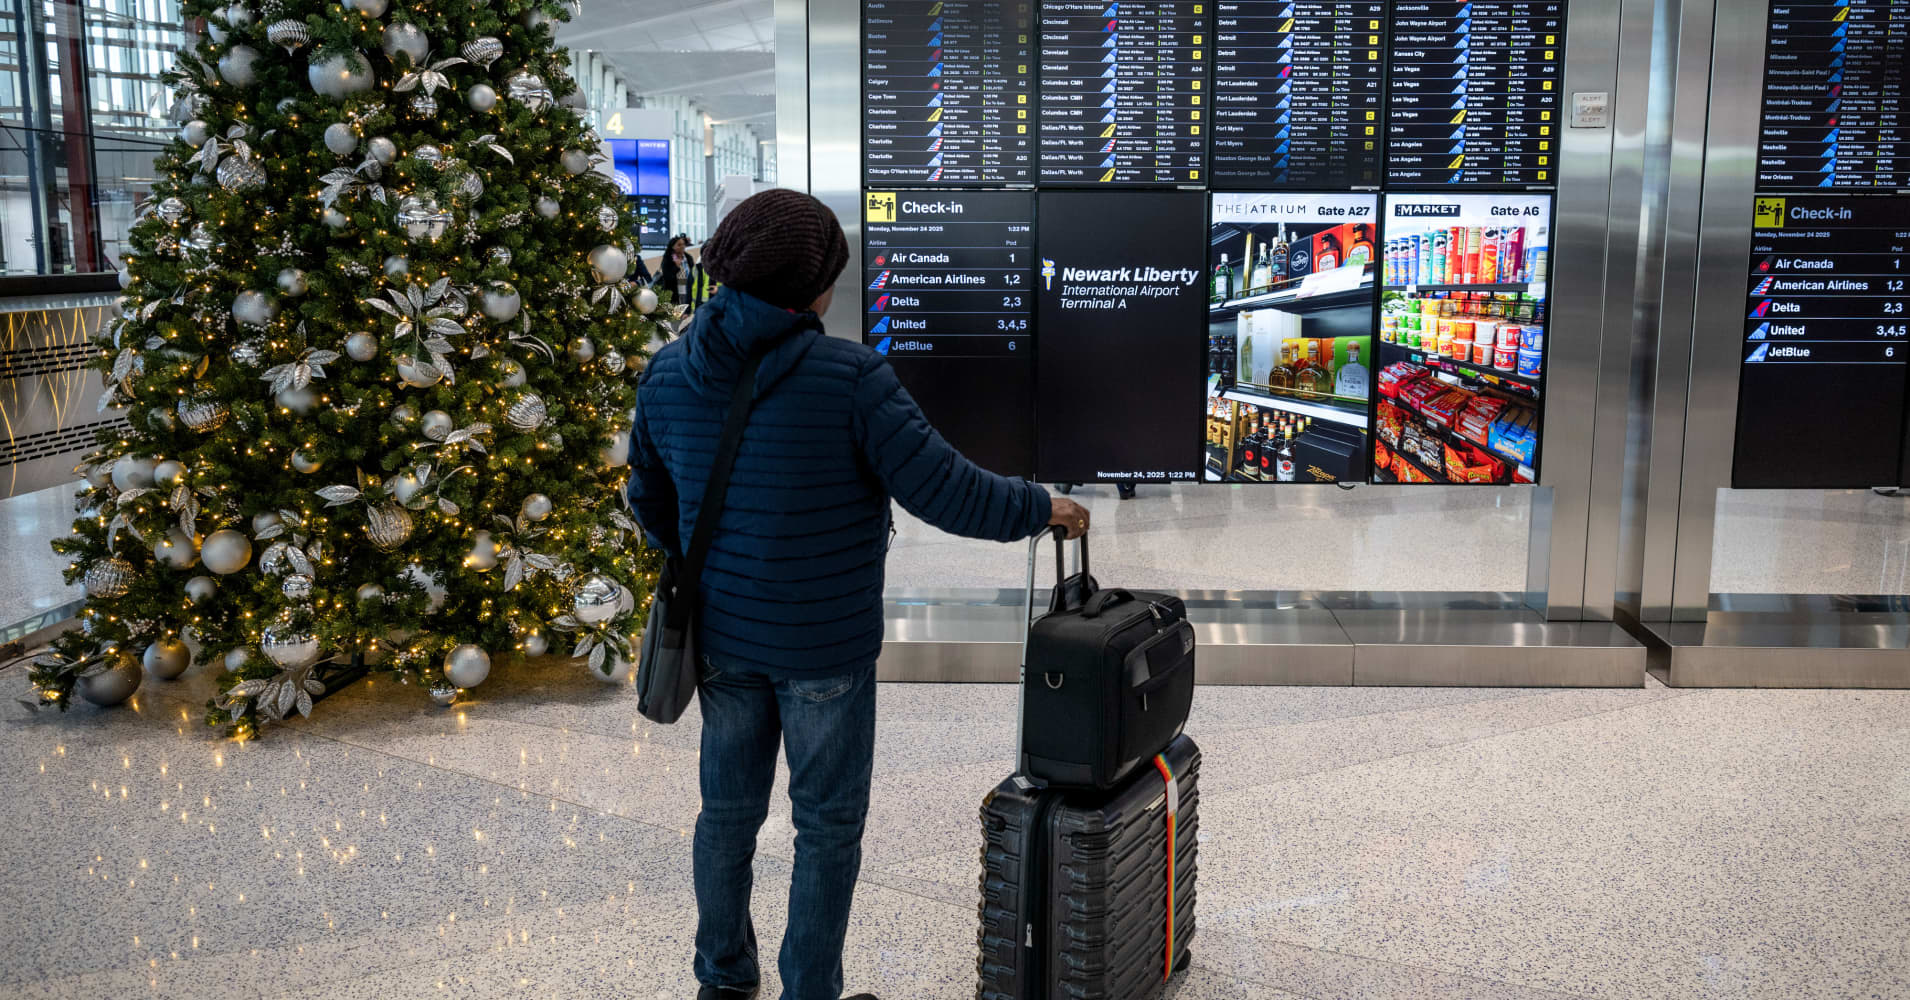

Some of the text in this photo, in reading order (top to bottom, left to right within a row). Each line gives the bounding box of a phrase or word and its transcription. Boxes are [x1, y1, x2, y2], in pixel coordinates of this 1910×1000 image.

[607, 112, 624, 134] 4
[902, 201, 963, 213] Check-in
[1216, 204, 1305, 213] THE ATRIUM
[1318, 207, 1370, 215] Gate A27
[1401, 204, 1458, 215] MARKET
[1491, 206, 1539, 216] Gate A6
[1791, 207, 1851, 219] Check-in
[892, 253, 949, 262] Air Canada
[1010, 254, 1014, 262] 1
[1776, 259, 1833, 268] Air Canada
[1894, 260, 1899, 268] 1
[892, 275, 985, 284] American Airlines
[1004, 275, 1020, 285] 1,2
[1063, 267, 1199, 285] Newark Liberty
[1774, 280, 1868, 290] American Airlines
[1887, 281, 1903, 291] 1,2
[1062, 285, 1180, 298] International Airport
[892, 297, 919, 306] Delta
[1003, 297, 1021, 307] 2,3
[1061, 298, 1126, 308] Terminal A
[1772, 303, 1800, 312] Delta
[1884, 303, 1902, 313] 2,3
[892, 320, 925, 328] United
[998, 320, 1026, 330] 3,4,5
[1771, 326, 1805, 335] United
[1877, 326, 1906, 336] 3,4,5
[892, 341, 932, 350] JetBlue
[1009, 341, 1015, 350] 6
[1769, 347, 1810, 356] JetBlue
[1886, 348, 1893, 356] 6
